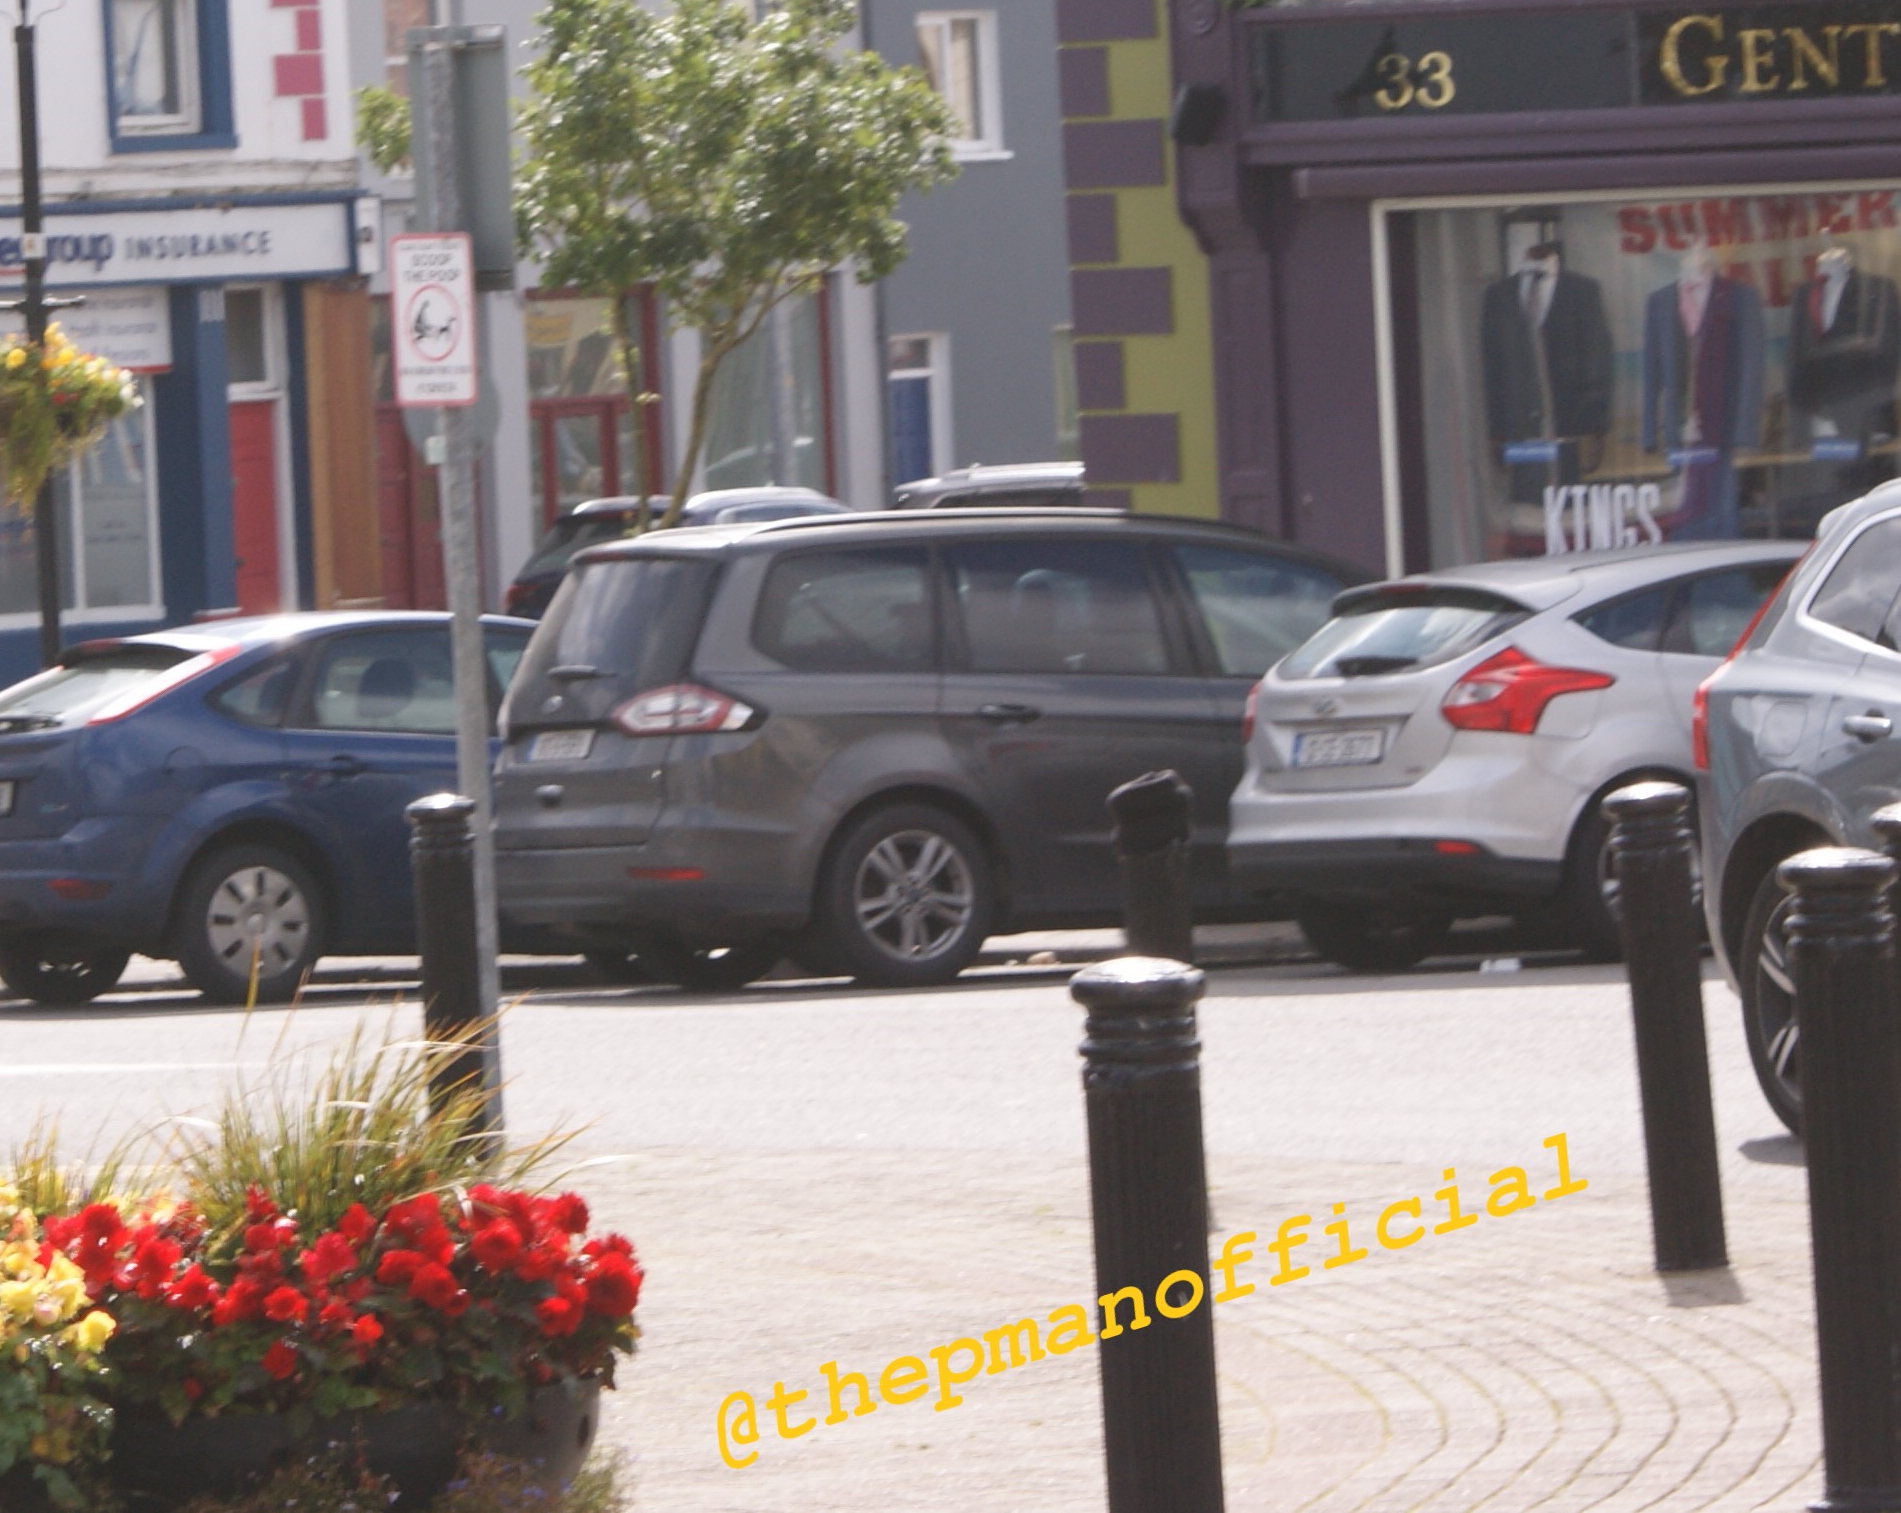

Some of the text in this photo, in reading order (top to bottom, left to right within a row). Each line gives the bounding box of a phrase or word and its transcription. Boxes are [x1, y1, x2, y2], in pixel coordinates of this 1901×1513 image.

[1376, 51, 1456, 110] 33
[124, 230, 272, 260] INSURANCE
[1618, 190, 1899, 254] SUMMER
[1543, 482, 1663, 553] KINGS
